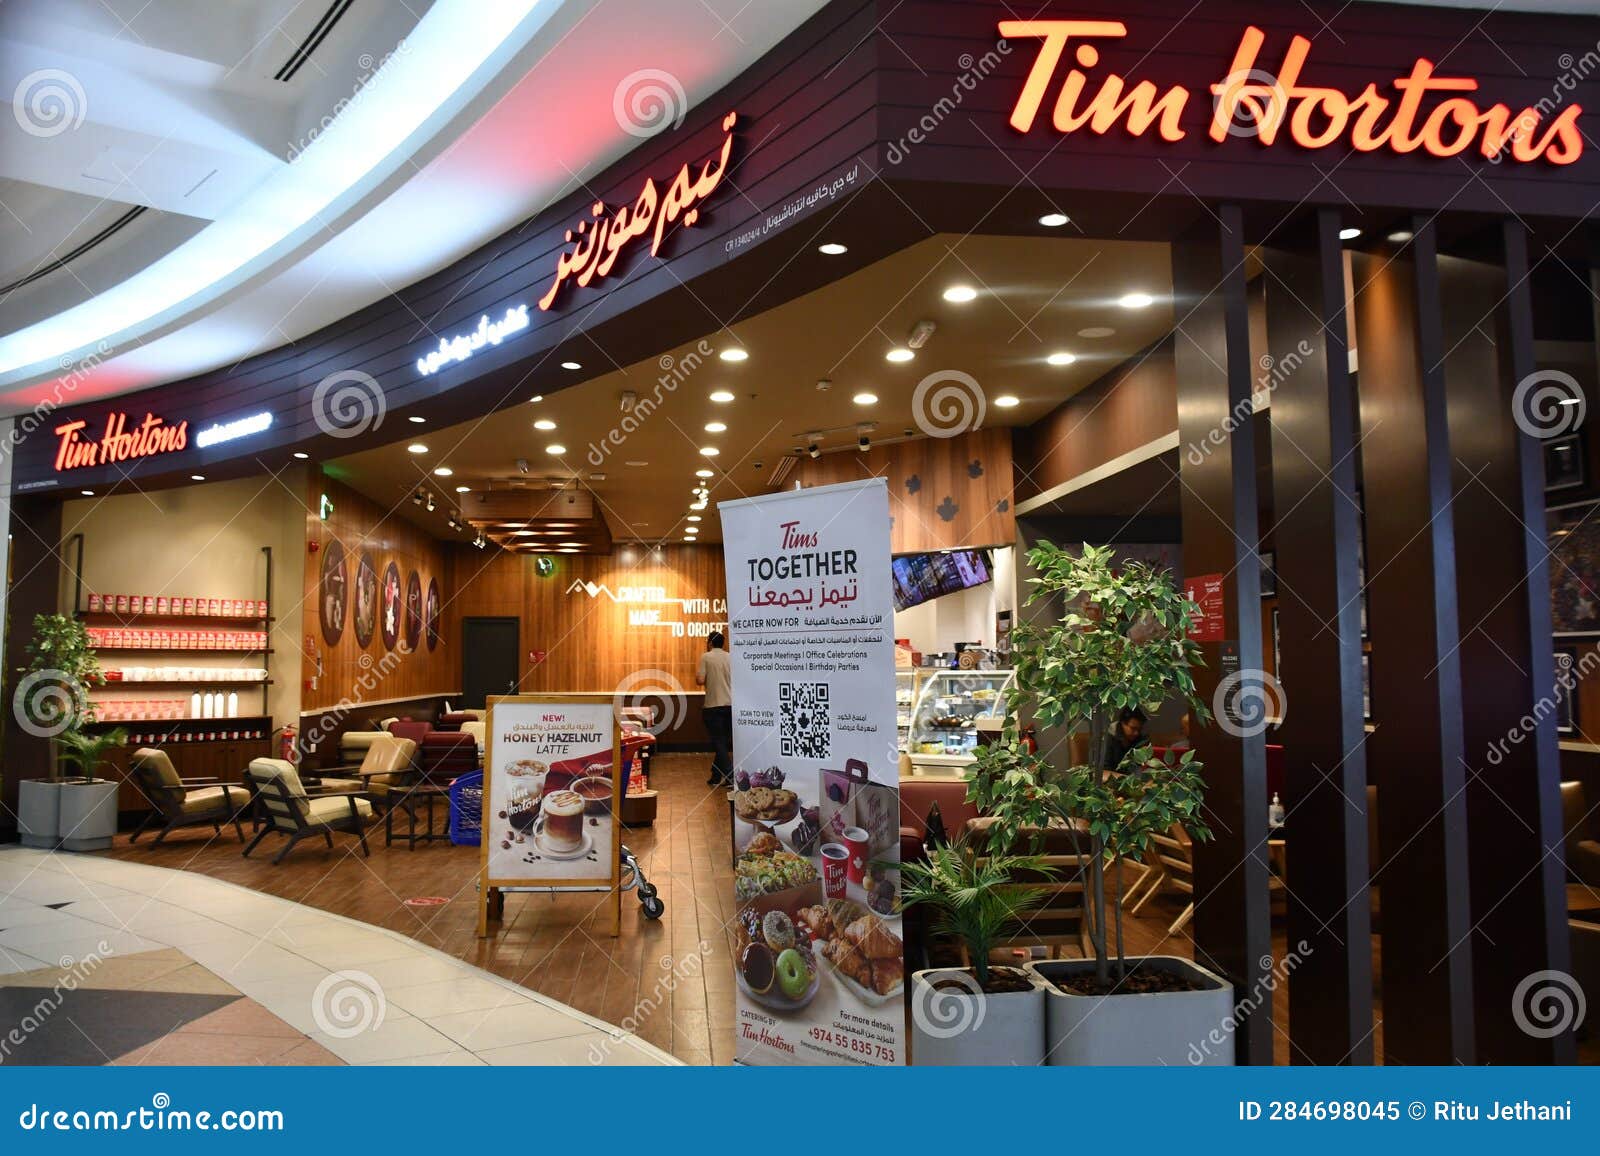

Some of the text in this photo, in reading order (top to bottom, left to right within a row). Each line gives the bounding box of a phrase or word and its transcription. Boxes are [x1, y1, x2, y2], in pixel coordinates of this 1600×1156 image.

[998, 20, 1584, 165] Tim Hortons
[806, 184, 828, 208] كافيه
[538, 111, 737, 311] تيم هورتنز
[725, 241, 734, 252] CR
[54, 420, 97, 471] Tim
[100, 412, 188, 465] Hortons
[780, 521, 818, 550] Tims
[747, 549, 858, 581] TOGETHER
[749, 578, 858, 611] تيمز يجمعنا
[683, 599, 727, 613] WITH CA
[671, 622, 723, 637] TO ORDER
[733, 617, 799, 628] WE CATER NOW FOR
[743, 652, 772, 661] Corporate
[774, 652, 801, 661] Meetings
[806, 650, 825, 659] Office
[826, 650, 868, 659] Celebrations
[751, 663, 773, 672] Special
[774, 663, 804, 671] Occasions
[809, 663, 836, 672] Birthday
[838, 663, 860, 671] Parties
[542, 714, 565, 722] NEW!
[504, 733, 603, 743] HONEY HAZELNUT
[536, 745, 569, 755] LATTE
[741, 1010, 768, 1023] CATERING
[840, 1010, 894, 1032] For more details
[741, 1022, 758, 1042] Tim
[760, 1028, 795, 1053] Hortons
[808, 1027, 832, 1043] +974
[835, 1034, 848, 1048] 55
[851, 1039, 872, 1055] 835
[875, 1045, 895, 1062] 753
